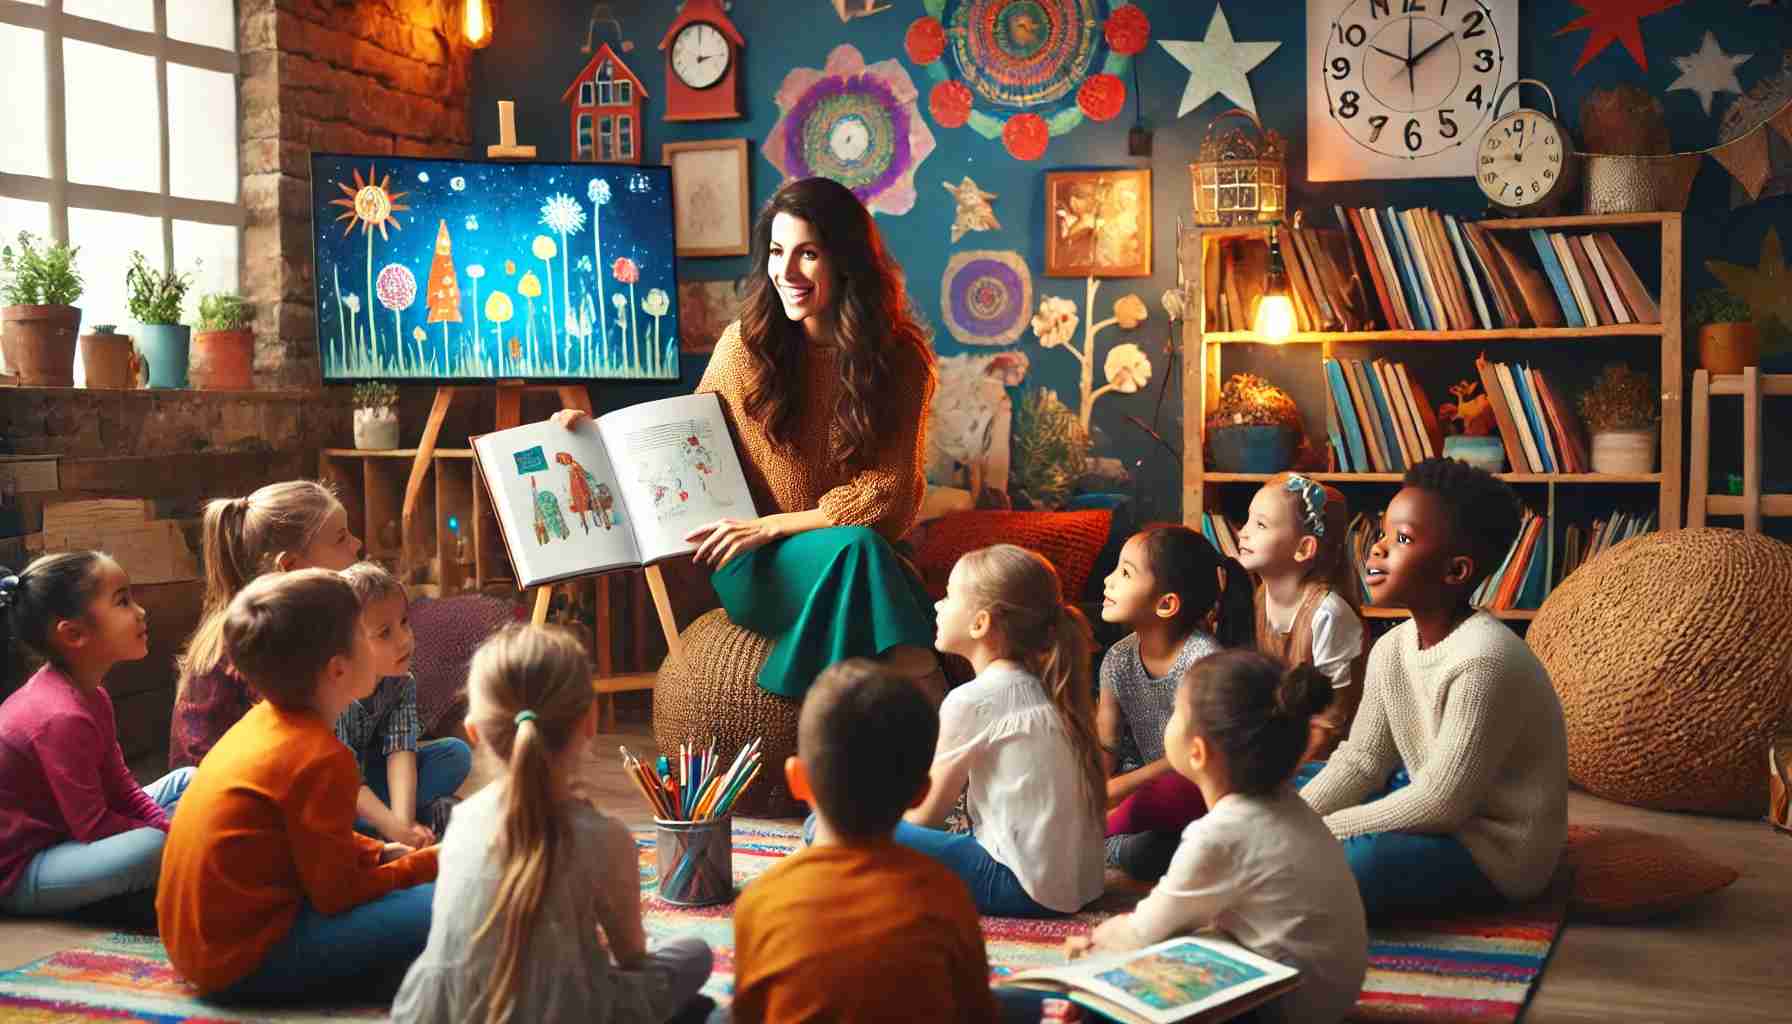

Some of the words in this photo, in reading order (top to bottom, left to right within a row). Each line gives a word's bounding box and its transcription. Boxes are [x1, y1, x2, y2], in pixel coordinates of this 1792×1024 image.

[1337, 23, 1366, 47] 10
[1462, 11, 1485, 39] 2
[1331, 57, 1351, 80] 9
[1474, 49, 1494, 73] 3
[1338, 91, 1360, 119] 8
[1466, 84, 1482, 111] 4
[1404, 119, 1422, 151] 6
[1438, 109, 1459, 138] 5
